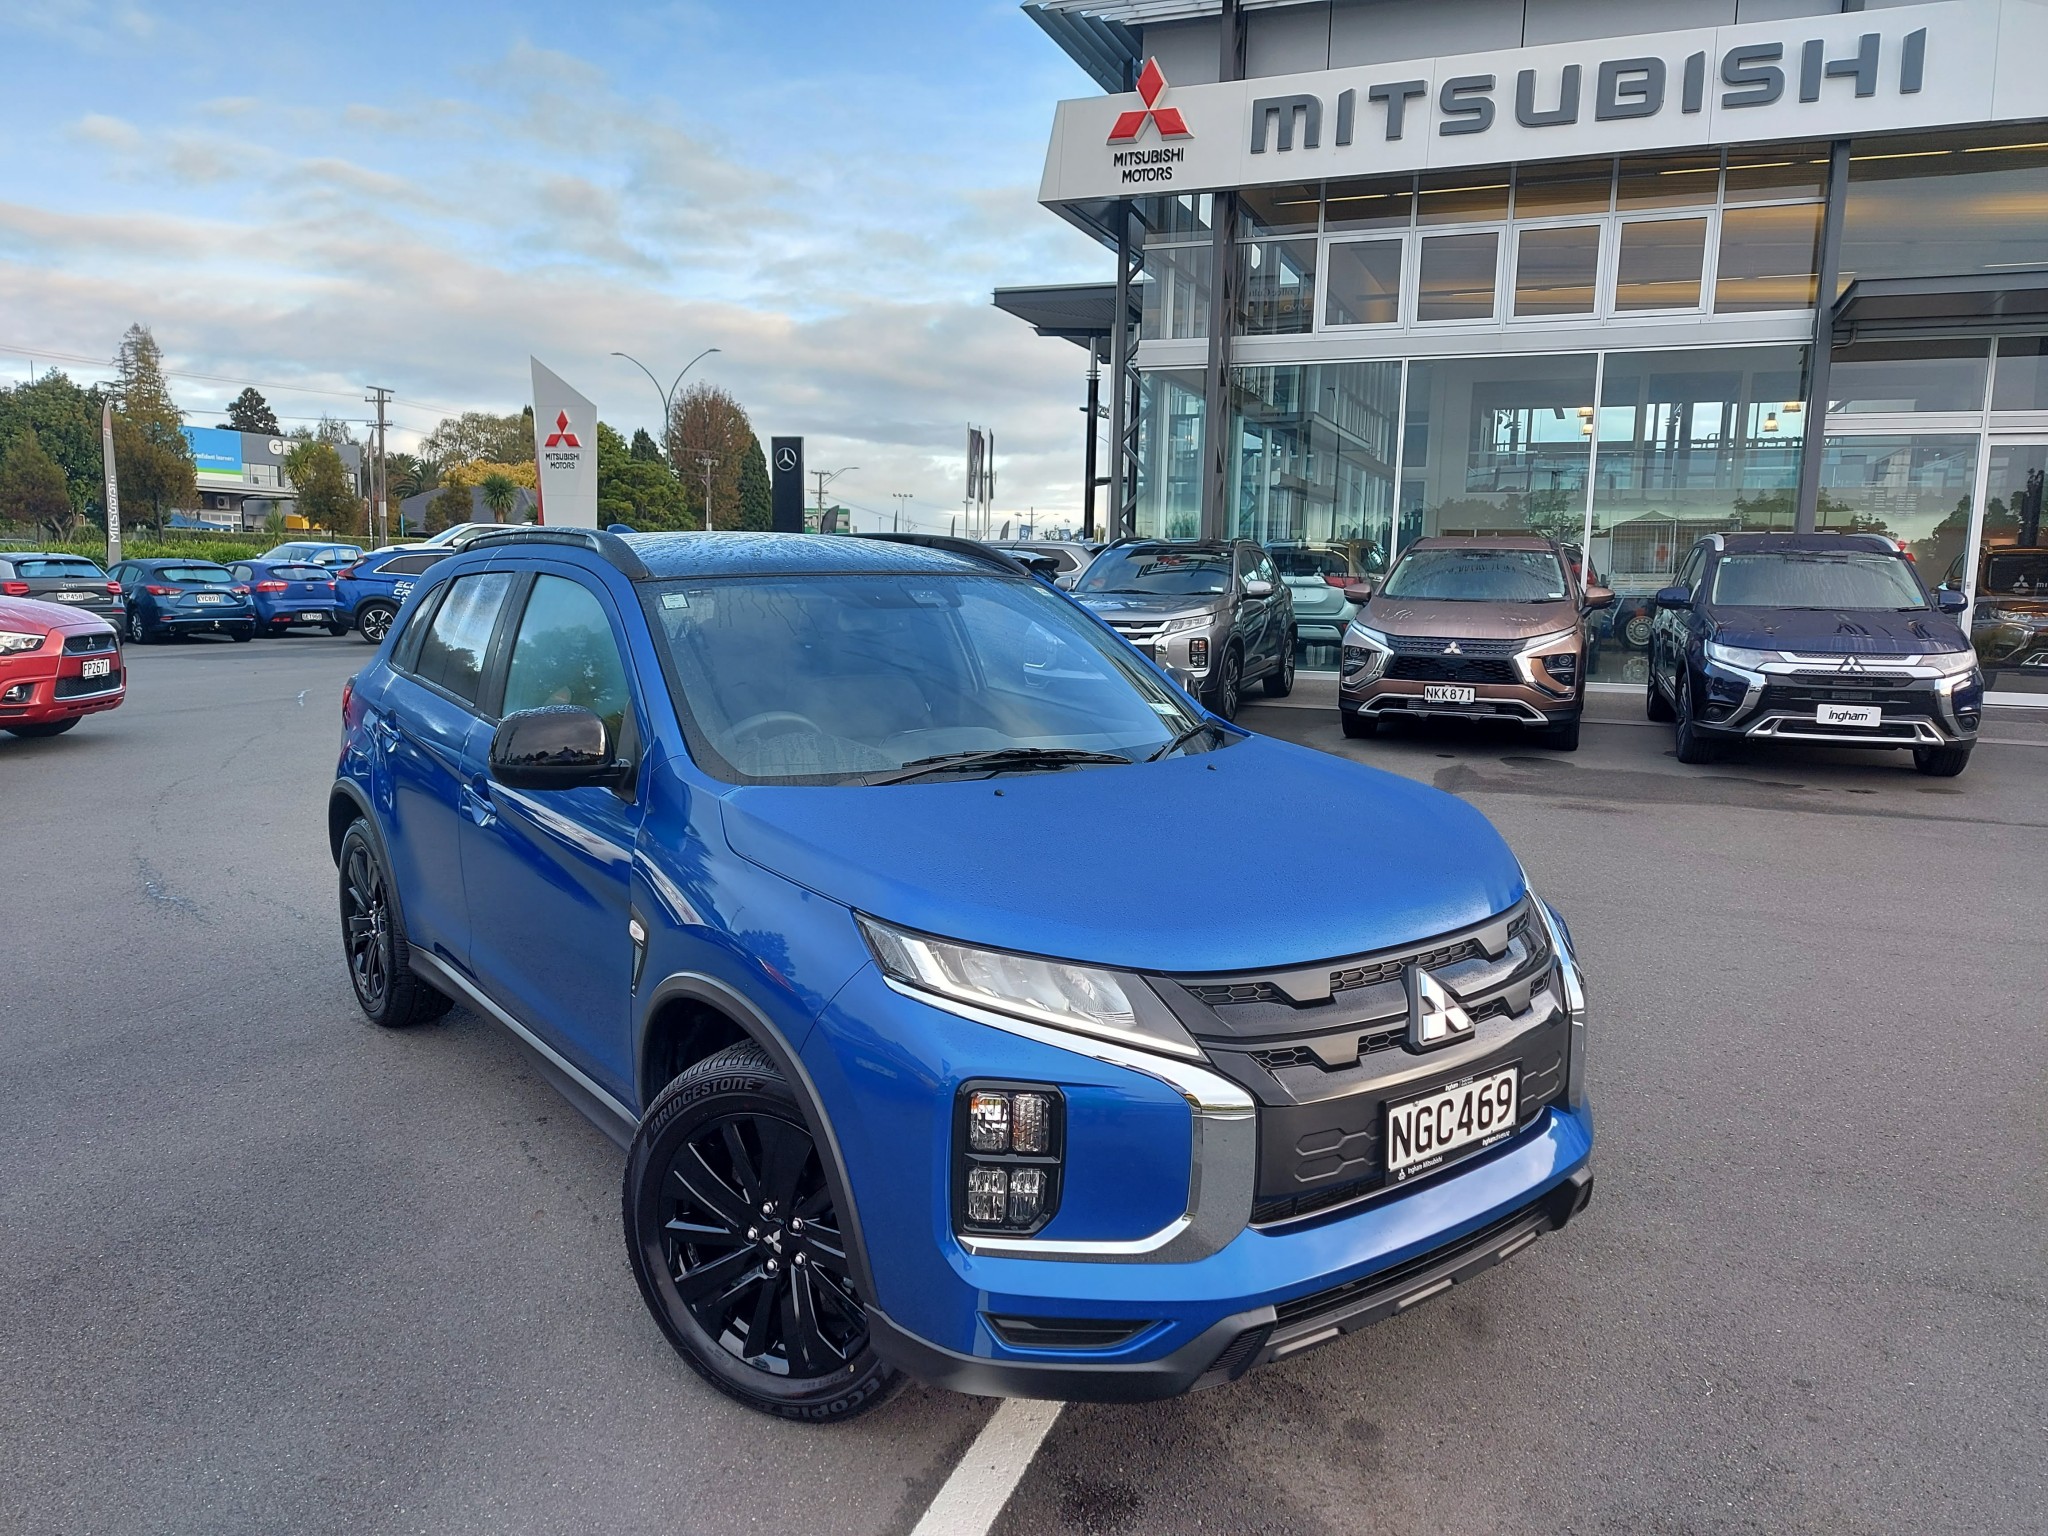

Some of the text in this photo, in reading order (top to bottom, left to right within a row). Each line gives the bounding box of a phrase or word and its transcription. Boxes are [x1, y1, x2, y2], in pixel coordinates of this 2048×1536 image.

[1250, 26, 1928, 155] MITSUBISHI
[1113, 147, 1185, 167] MITSUBISHI
[1121, 166, 1173, 184] MOTORS
[545, 452, 580, 461] MITSUBISHI
[550, 461, 576, 470] MOTORS
[83, 661, 109, 676] FPZ671
[1426, 687, 1471, 701] NKK871
[1828, 709, 1868, 722] Ingham
[650, 1077, 755, 1135] BRIDGESTONE
[1392, 1077, 1513, 1164] NGC469
